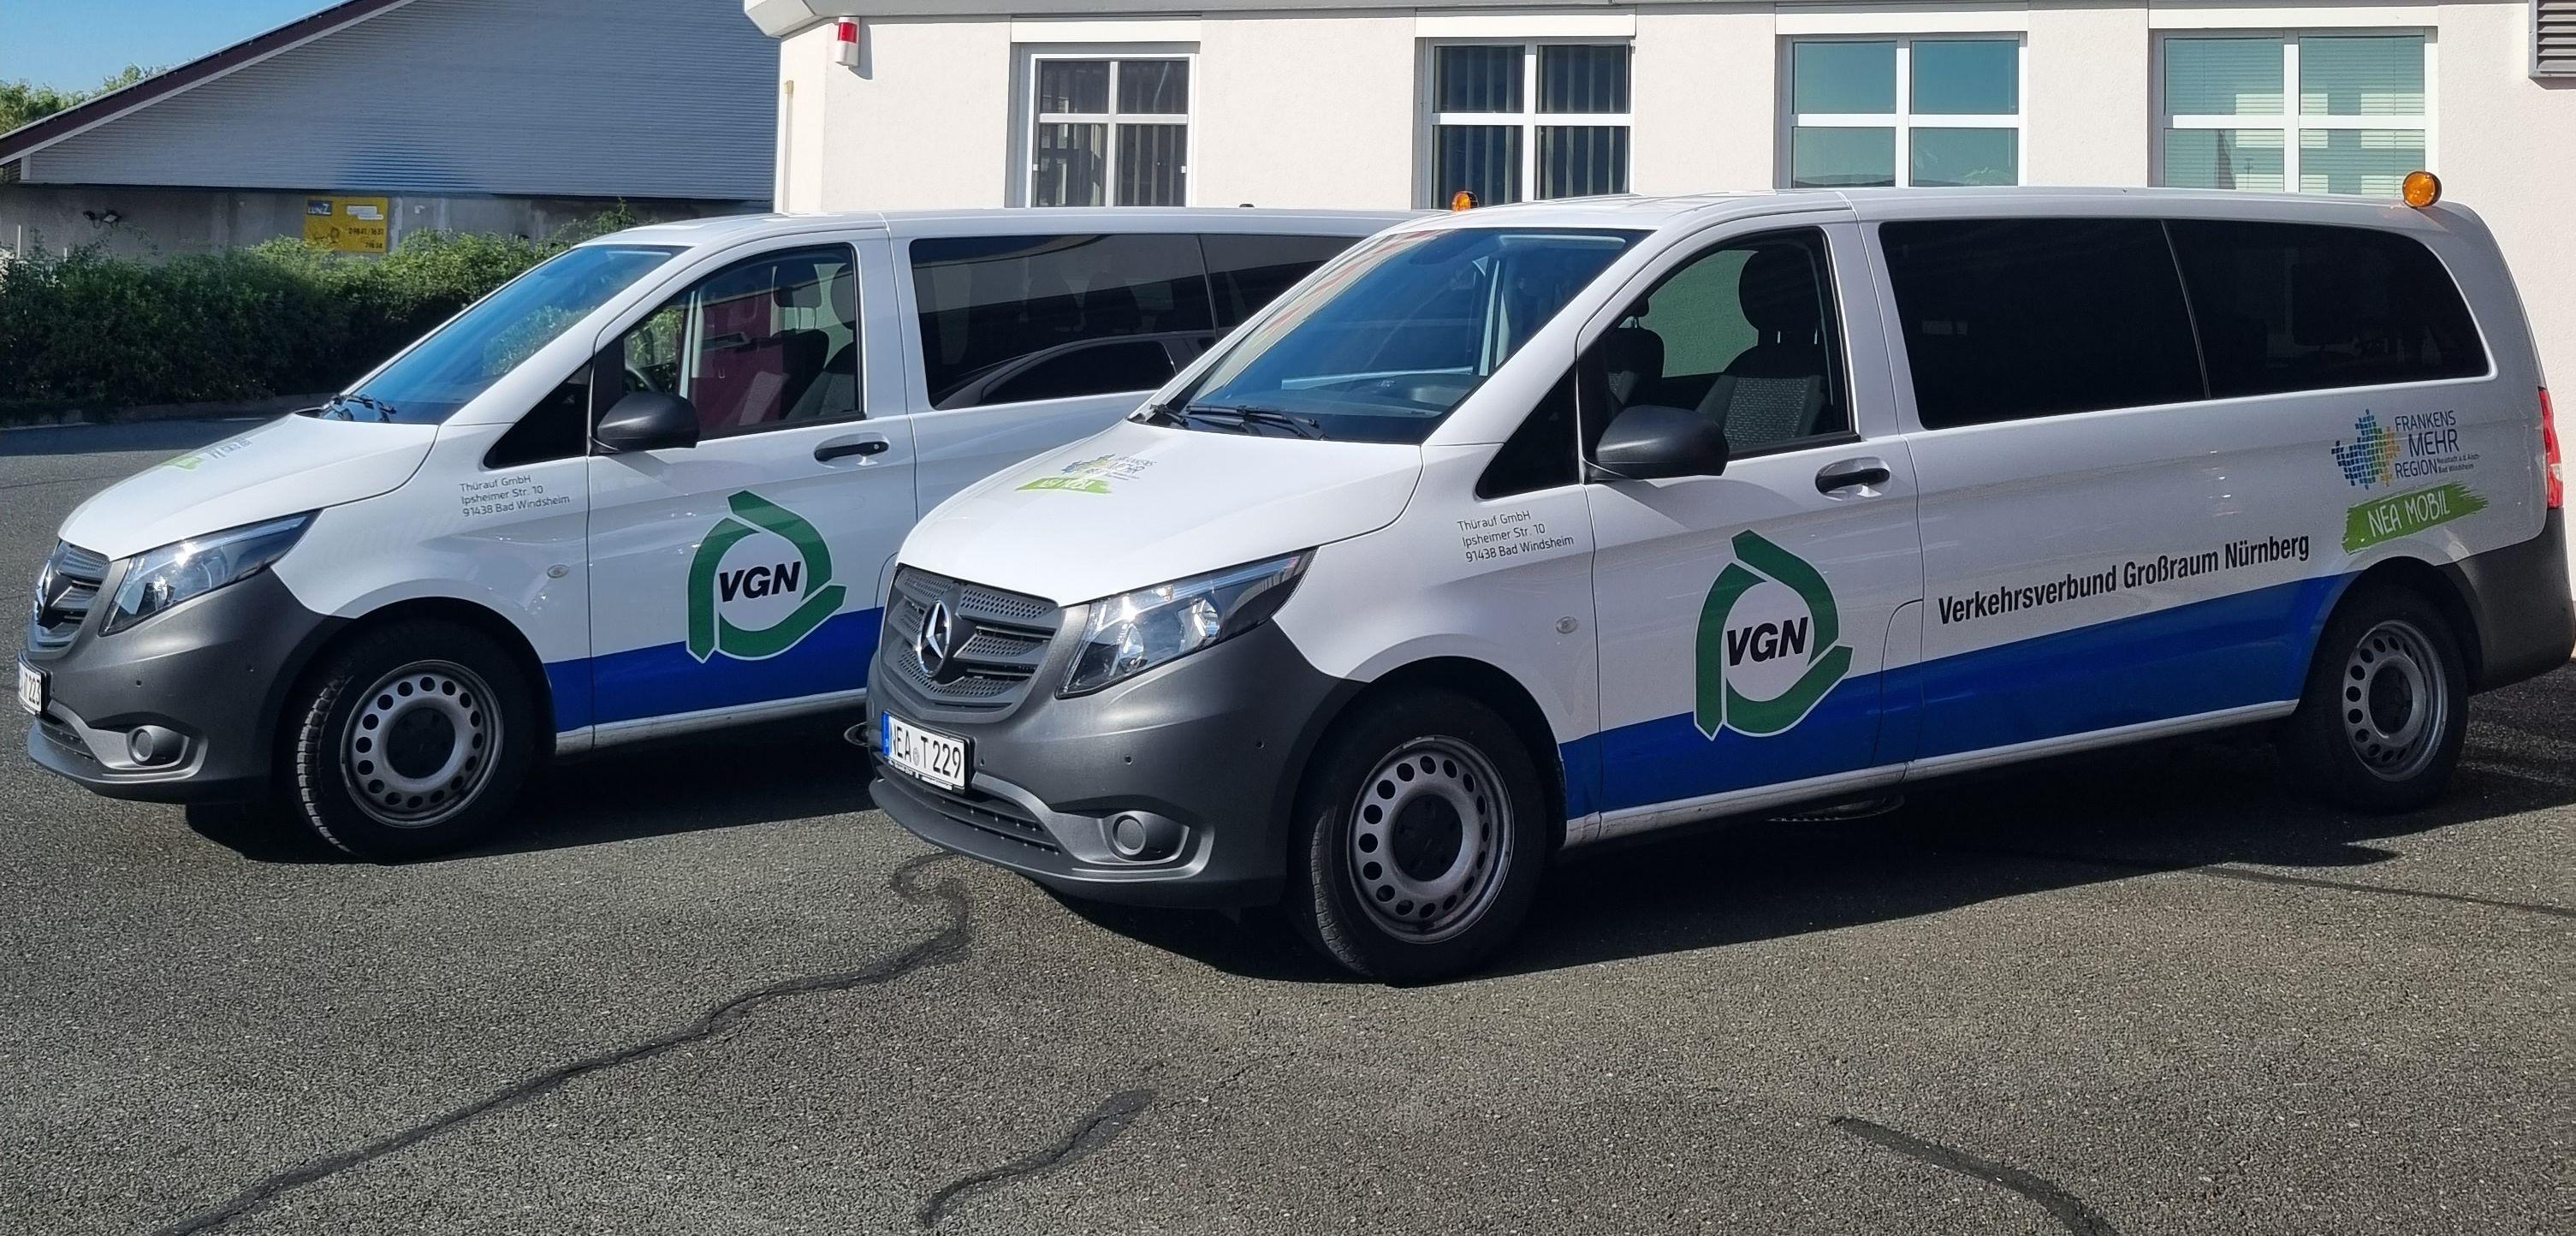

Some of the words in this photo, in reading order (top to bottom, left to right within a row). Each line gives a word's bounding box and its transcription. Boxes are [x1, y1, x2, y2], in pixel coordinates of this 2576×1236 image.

[2395, 410, 2456, 431] FRANKENS
[2408, 428, 2460, 457] MEHR
[2395, 459, 2438, 478] REGION
[460, 479, 498, 491] Thürauf
[501, 474, 531, 486] GmbH
[461, 491, 509, 506] Ipsheimer
[512, 488, 530, 497] Str.
[532, 485, 543, 495] 10
[462, 505, 493, 517] 91438
[496, 502, 514, 513] Bad
[516, 496, 570, 510] Windsheim
[2367, 503, 2402, 538] NEA
[2405, 490, 2450, 525] MOBIL
[1457, 515, 1498, 532] Thürauf
[1499, 510, 1531, 525] GmbH
[1462, 531, 1511, 549] Ipsheimer
[1513, 527, 1532, 538] Str.
[1533, 523, 1546, 534] 10
[1465, 548, 1497, 562] 91438
[1499, 544, 1518, 557] Bad
[1519, 536, 1575, 553] Windsheim
[719, 561, 801, 603] VGN
[1938, 565, 2117, 625] Verkehrsverbund
[2124, 550, 2219, 589] Großraum
[2225, 534, 2310, 569] Nürnberg
[1726, 616, 1808, 667] VGN
[890, 722, 911, 764] NEA
[921, 735, 929, 769] T
[933, 740, 961, 779] 229
